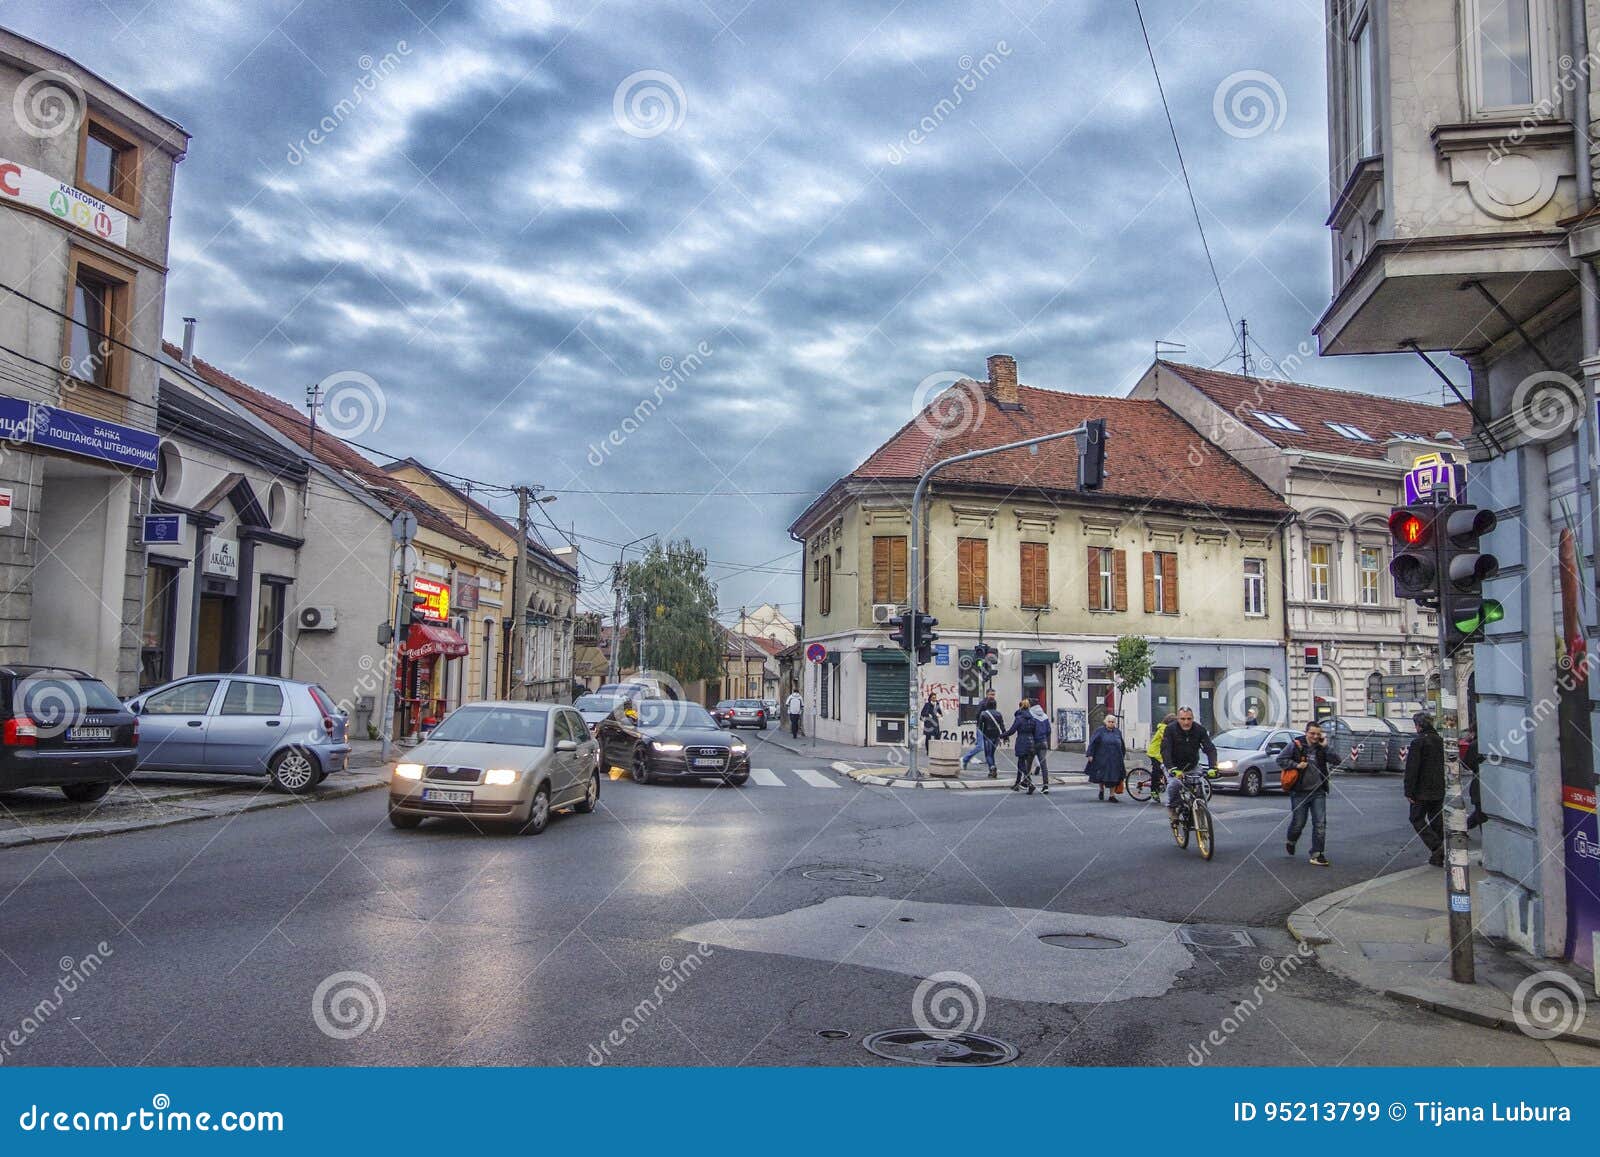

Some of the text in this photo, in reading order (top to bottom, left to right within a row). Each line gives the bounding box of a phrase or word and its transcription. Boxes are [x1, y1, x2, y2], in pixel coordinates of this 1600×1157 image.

[60, 183, 106, 212] КАТЕГОРИЈЕ
[50, 427, 157, 462] ПОШТАНСКА ШТЕДИОНИЦА
[94, 426, 120, 440] БАНКА
